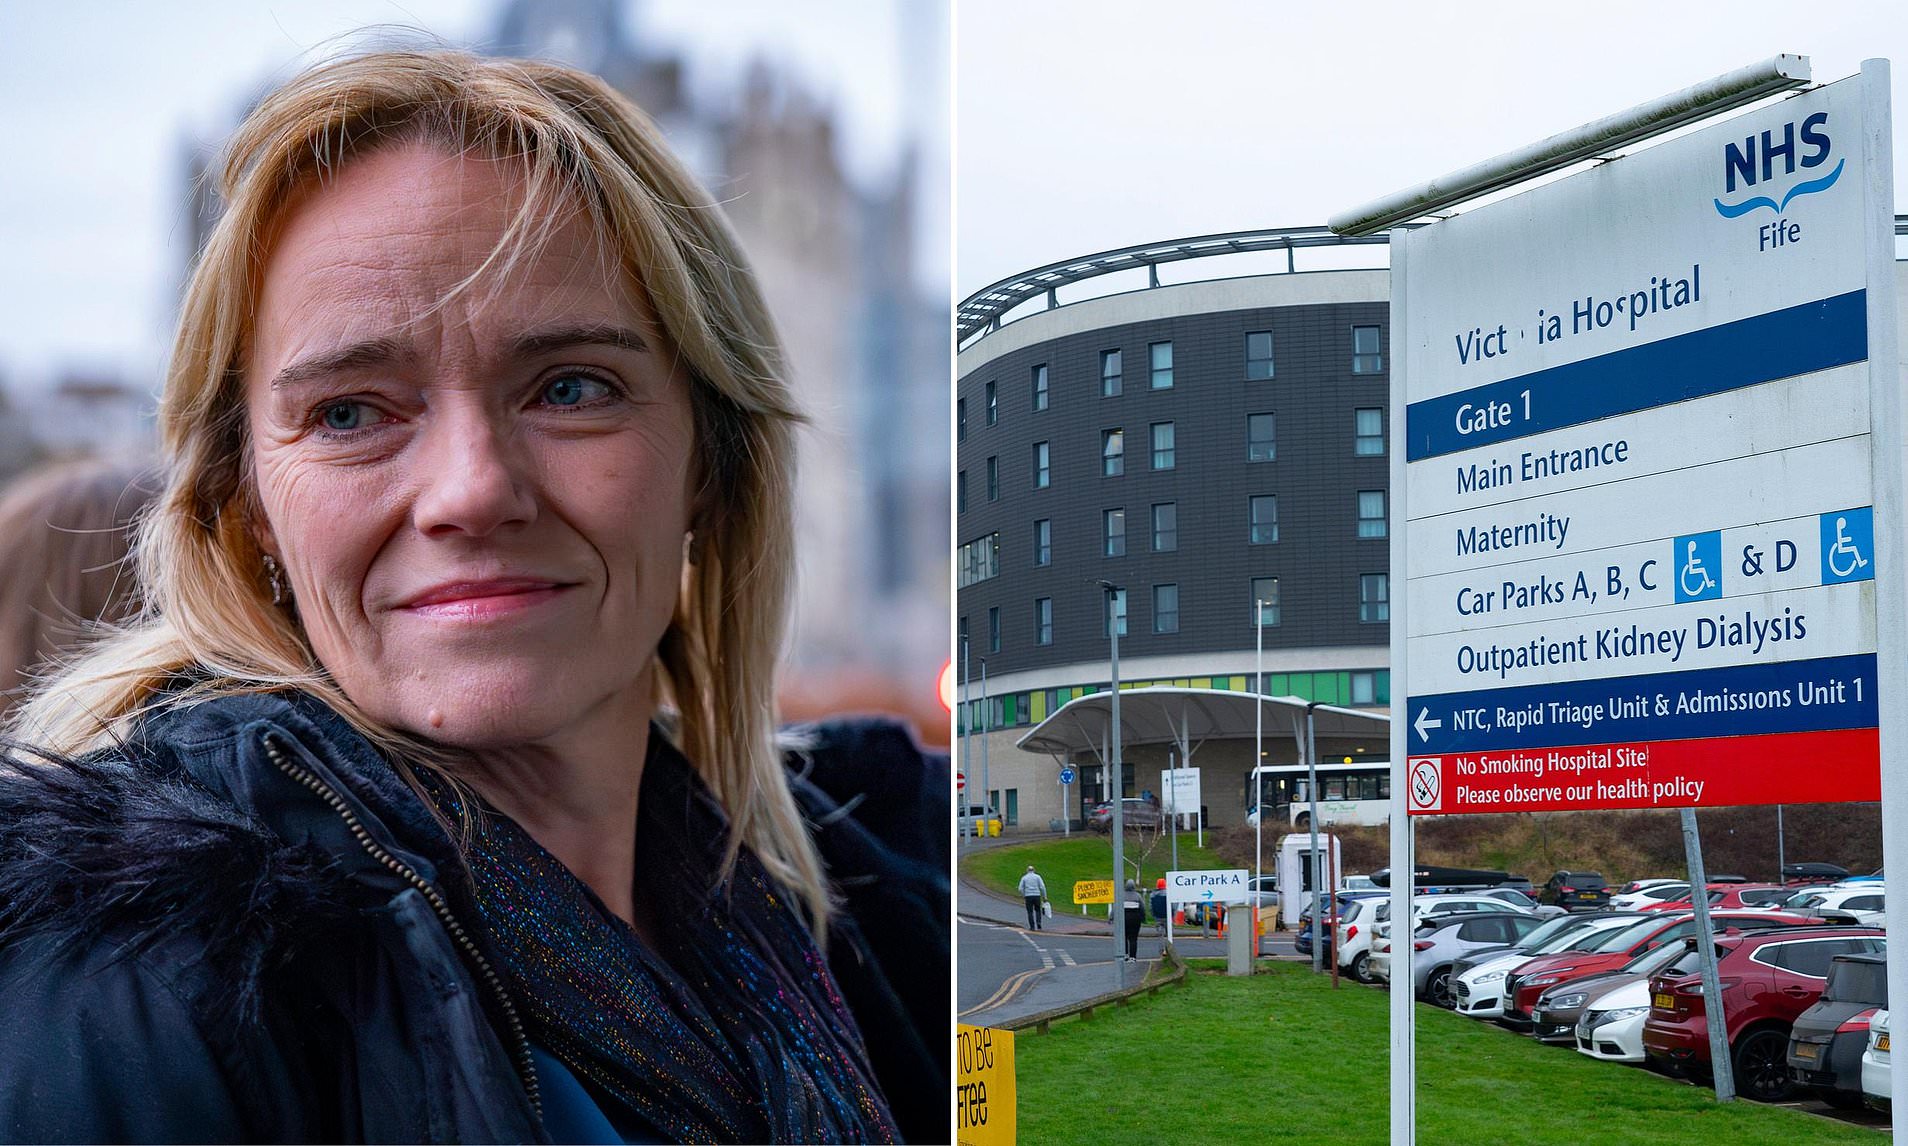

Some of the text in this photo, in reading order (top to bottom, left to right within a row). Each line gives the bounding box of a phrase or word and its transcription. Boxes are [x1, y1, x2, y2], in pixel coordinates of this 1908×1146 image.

[1726, 113, 1831, 193] NHS
[1760, 219, 1800, 251] Fife
[1456, 310, 1561, 364] Victia
[1456, 390, 1530, 434] Gate 1
[1458, 441, 1627, 494] Main Entrance
[1457, 513, 1571, 557] Maternity
[1457, 540, 1796, 616] Car Parks A, B, C & D
[1458, 607, 1806, 679] Outpatient Kidney Dialysis
[1454, 678, 1861, 733] NTC, Rapid Triage Unit & Admissions Unit 1
[1457, 748, 1646, 777] No Smoking Hospital Site
[1457, 777, 1704, 803] Please observe our health policy
[1176, 874, 1240, 886] Car Park A
